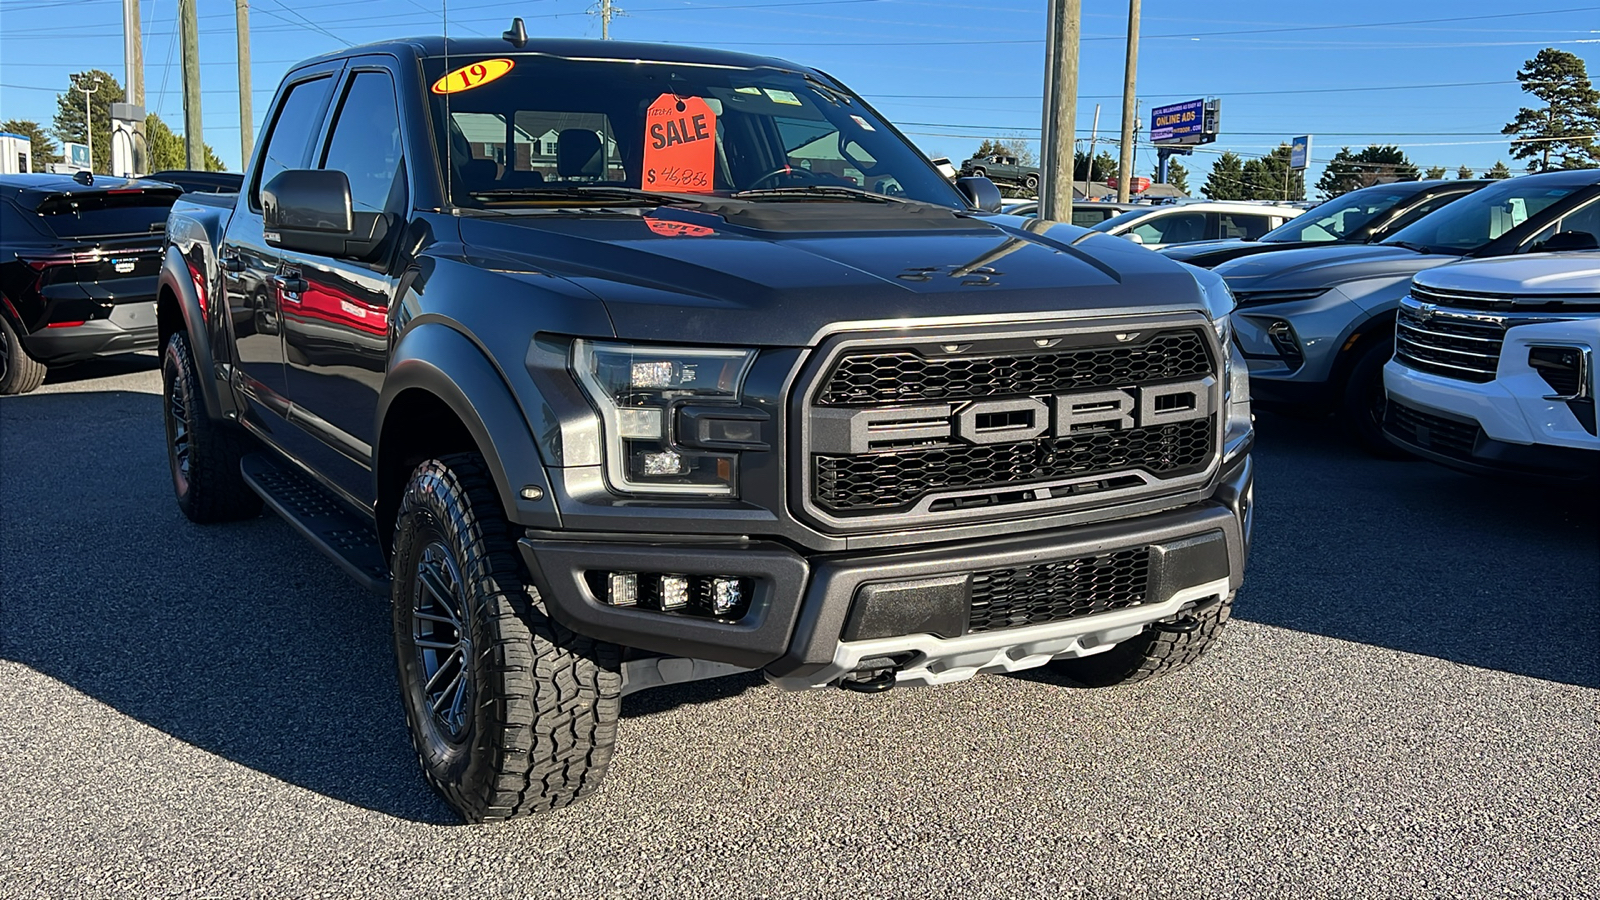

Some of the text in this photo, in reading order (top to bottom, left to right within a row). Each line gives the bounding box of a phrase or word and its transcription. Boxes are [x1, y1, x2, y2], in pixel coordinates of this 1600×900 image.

[457, 64, 487, 88] 19
[650, 114, 710, 150] SALE
[1156, 111, 1196, 126] ONLINE ADS
[850, 376, 1214, 454] FORD
